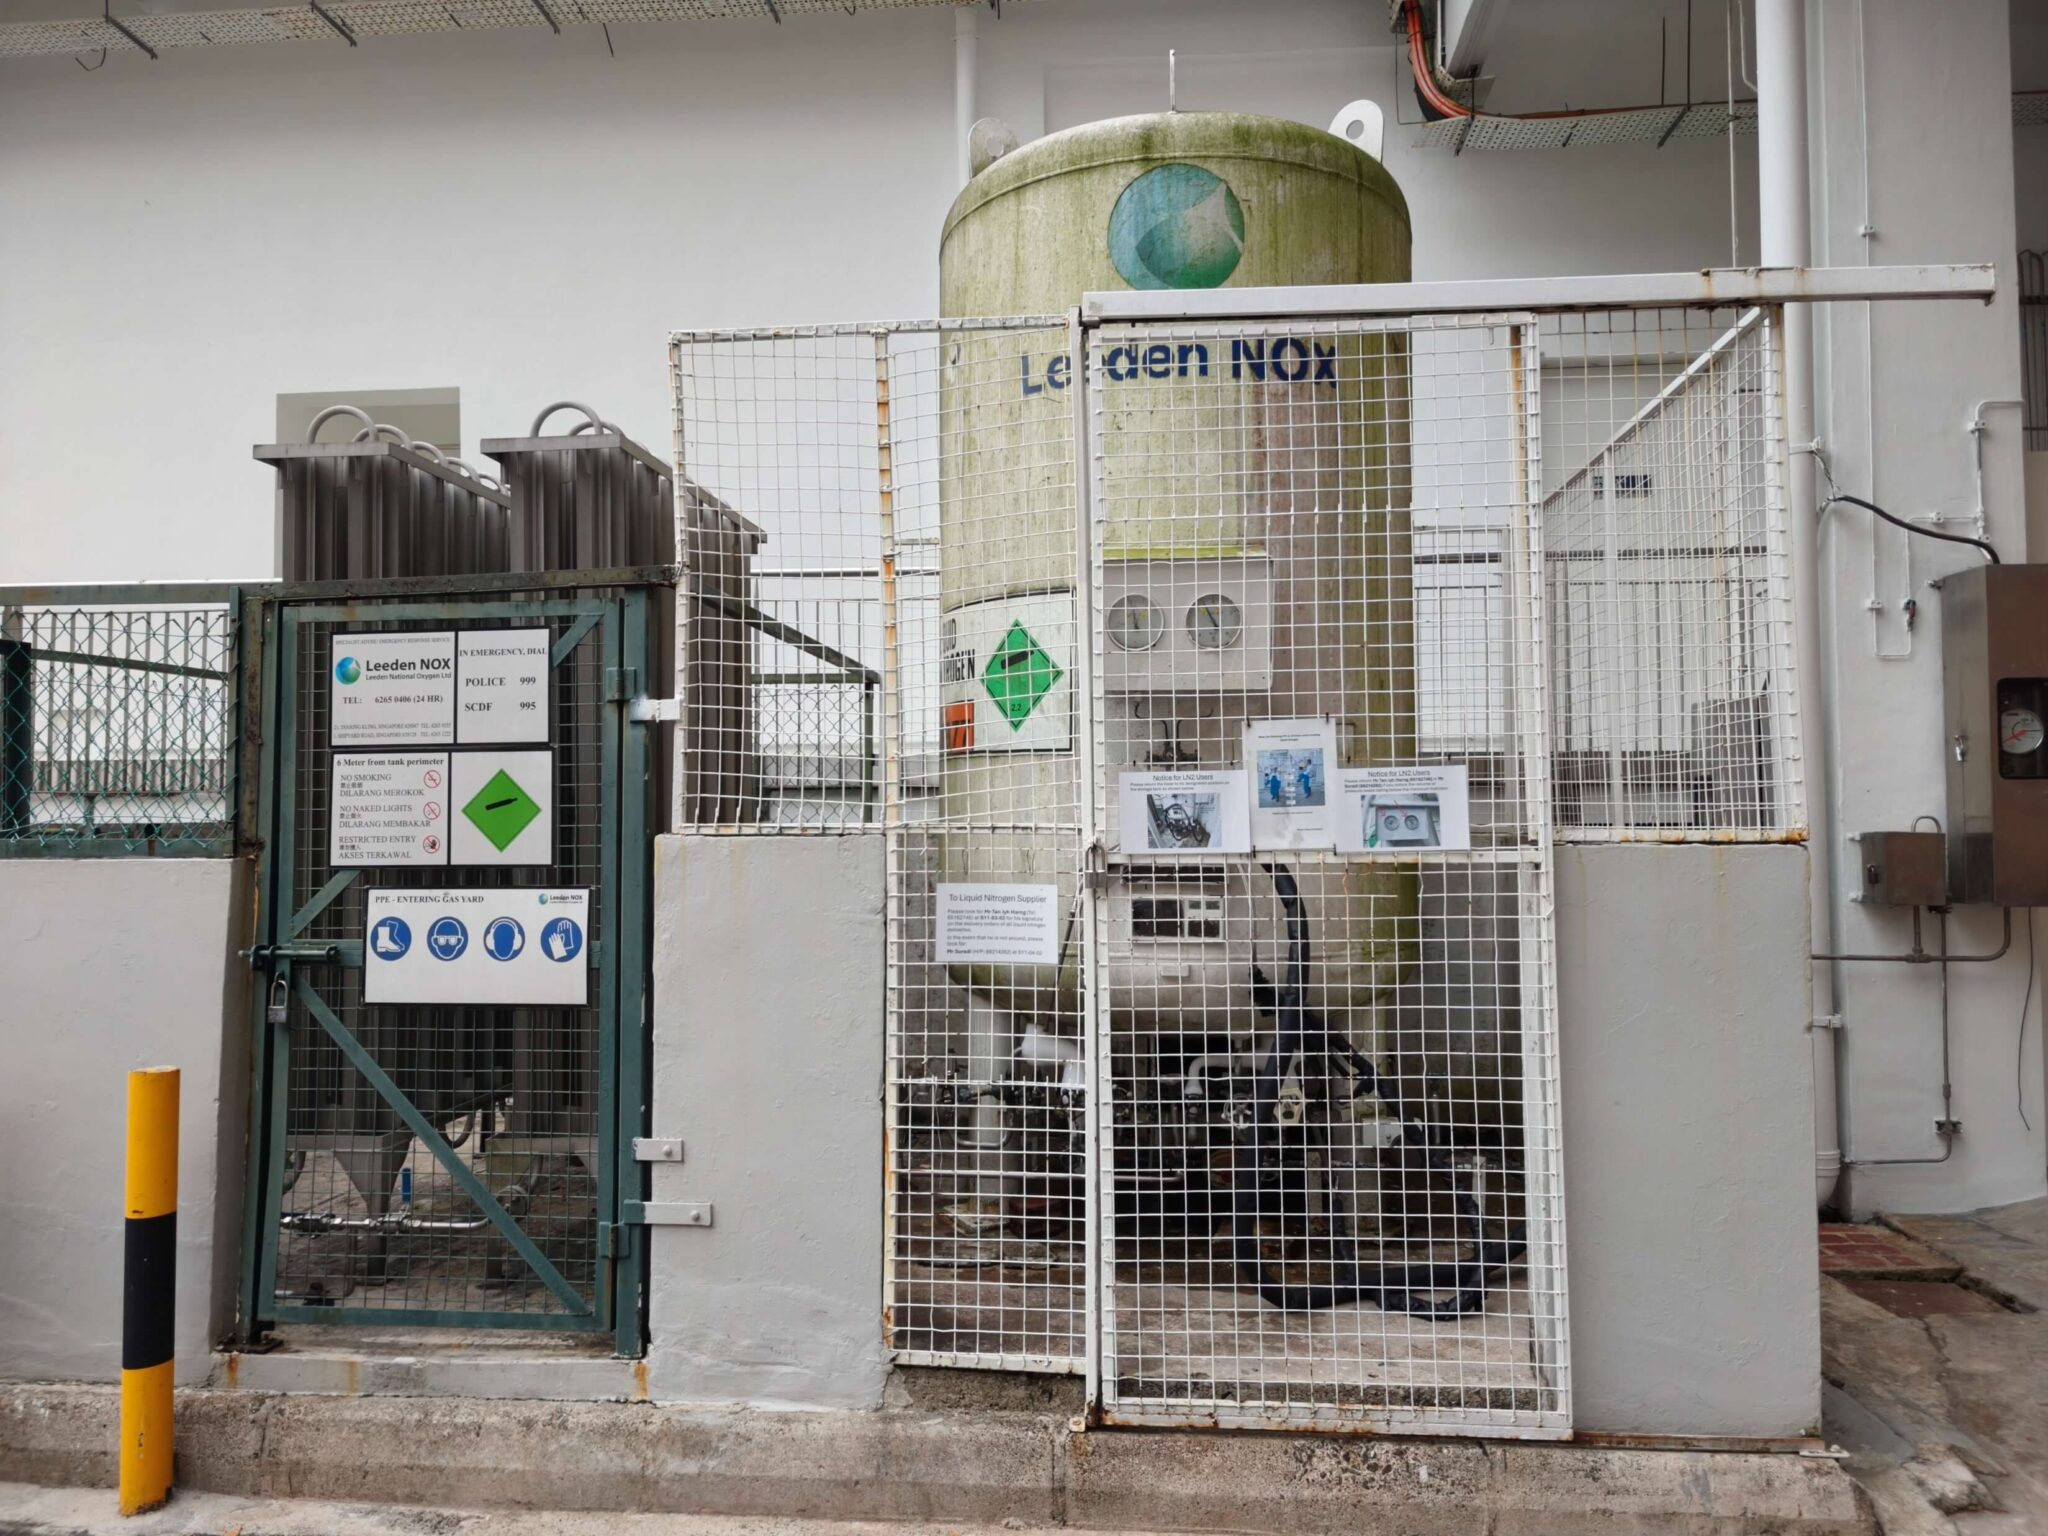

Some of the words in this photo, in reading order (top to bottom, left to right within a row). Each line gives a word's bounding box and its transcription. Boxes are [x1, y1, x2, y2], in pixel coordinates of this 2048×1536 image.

[1020, 343, 1217, 395] Leden
[471, 648, 525, 656] EMERGENCY,
[366, 659, 416, 671] Leeden
[421, 658, 451, 670] NOX
[466, 677, 506, 687] POLICE
[520, 676, 536, 685] 999
[344, 696, 362, 704] TEL:
[374, 696, 392, 704] 6265
[413, 695, 424, 703] (24
[427, 695, 443, 703] HR)
[464, 702, 492, 712] SCDF
[520, 702, 536, 710] 995
[406, 758, 444, 767] perimeter
[354, 774, 392, 782] SMOKING
[384, 804, 412, 812] LIGHTS
[383, 820, 430, 828] MEMBAKAR
[338, 836, 388, 844] RESTRICTED
[949, 894, 958, 902] To
[960, 894, 982, 902] Liquid
[984, 894, 1016, 903] Nitrogen
[1017, 894, 1046, 904] Supplier
